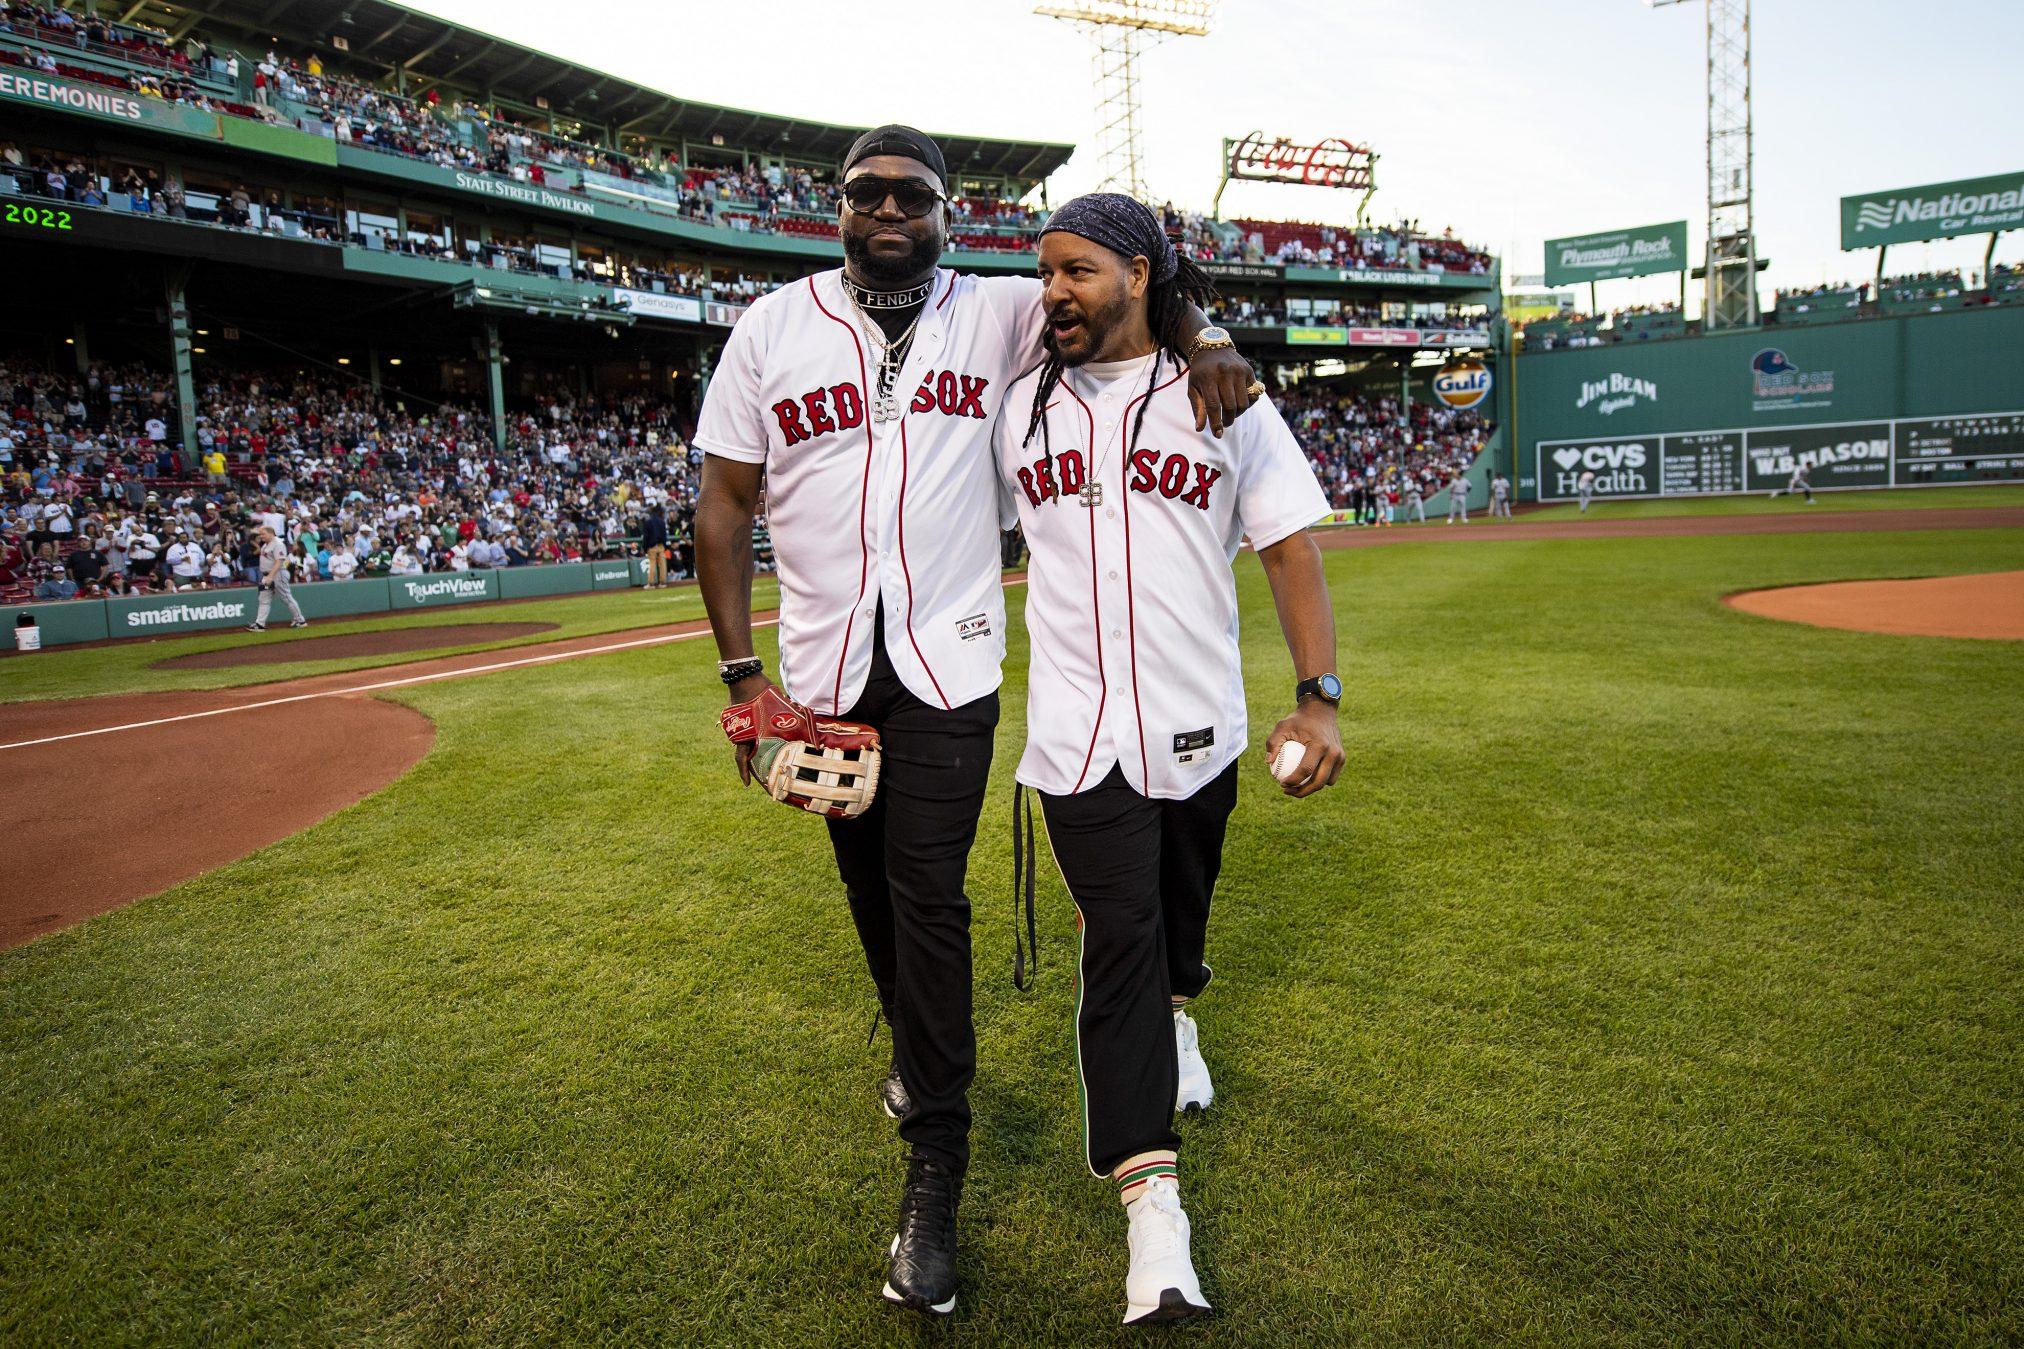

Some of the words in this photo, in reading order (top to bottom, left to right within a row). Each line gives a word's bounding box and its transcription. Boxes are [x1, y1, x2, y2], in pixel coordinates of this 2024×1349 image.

[0, 73, 142, 119] EREMONIES
[456, 173, 494, 194] STATE
[495, 181, 538, 202] STREET
[541, 191, 595, 215] PAVILION
[1895, 185, 2024, 224] National
[5, 203, 72, 230] 2022
[1940, 217, 1968, 230] Car
[867, 292, 912, 306] FENDI
[1436, 372, 1487, 393] Gulf
[1576, 379, 1608, 408] JIM
[1610, 372, 1657, 401] BEAM
[772, 382, 863, 447] RED
[910, 369, 989, 420] SOX
[1583, 443, 1647, 470] CVS
[1017, 449, 1086, 510] RED
[1130, 449, 1222, 510] SOX
[1556, 469, 1647, 495] Halth
[405, 578, 487, 603] TouchView
[127, 602, 245, 627] smartwater
